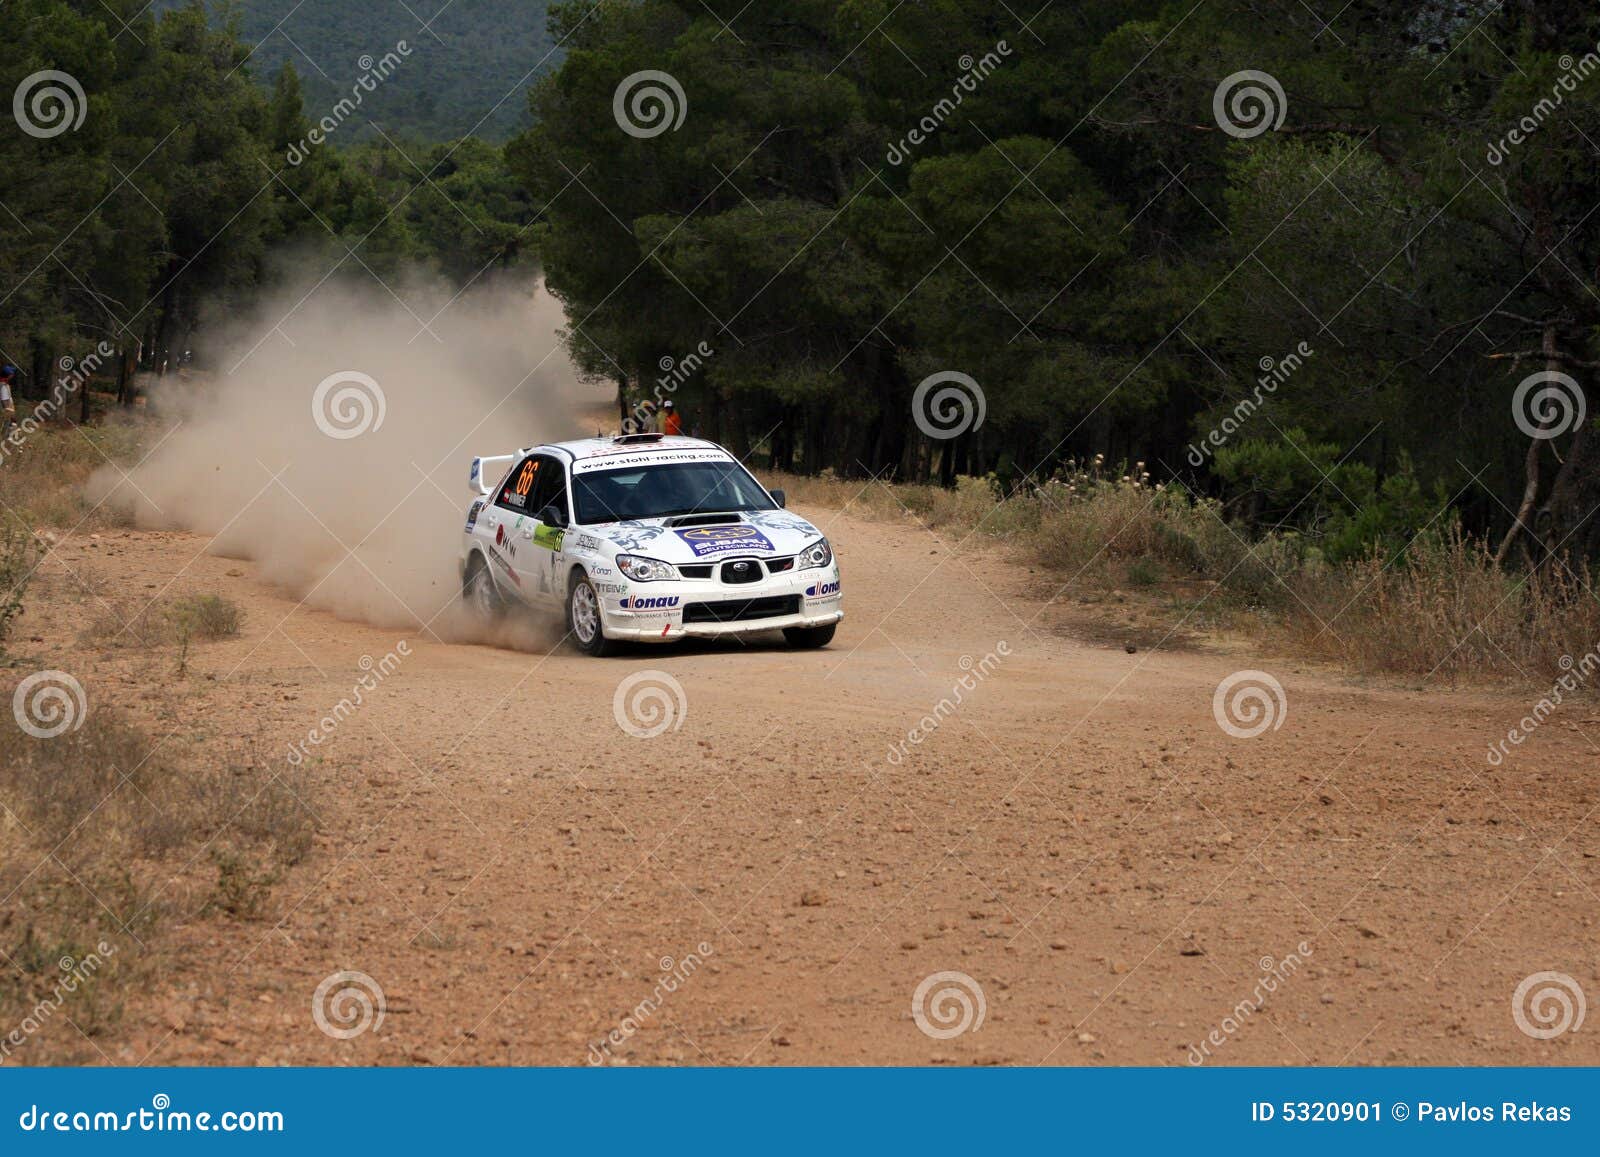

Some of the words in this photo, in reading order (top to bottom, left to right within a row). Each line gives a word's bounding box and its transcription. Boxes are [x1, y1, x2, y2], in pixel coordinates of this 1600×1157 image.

[581, 453, 724, 469] www.stohl-racing.com
[516, 460, 539, 496] 66
[694, 539, 768, 550] SUBARU
[699, 543, 769, 554] DEUTSCHLAND
